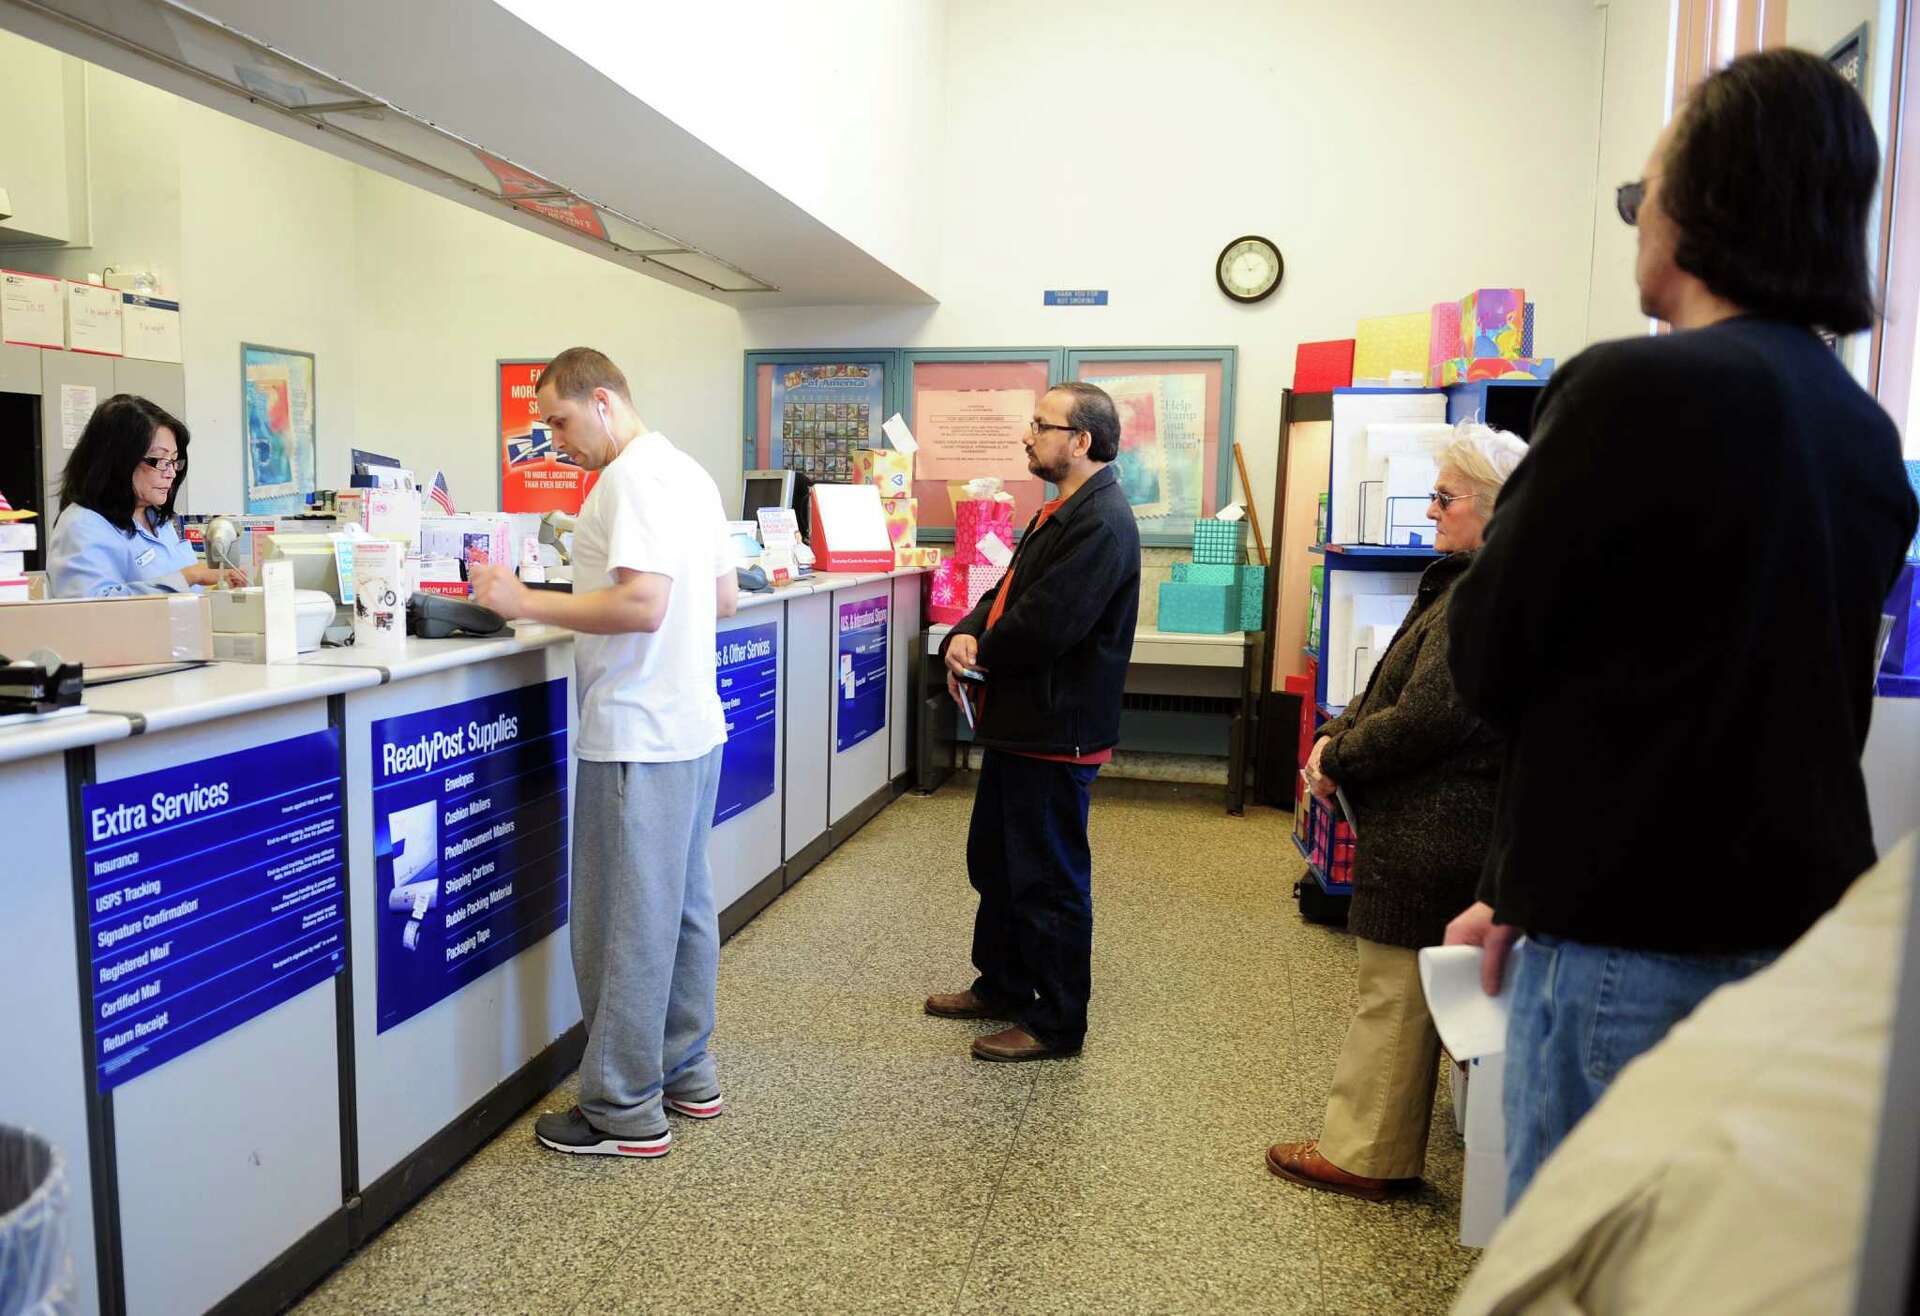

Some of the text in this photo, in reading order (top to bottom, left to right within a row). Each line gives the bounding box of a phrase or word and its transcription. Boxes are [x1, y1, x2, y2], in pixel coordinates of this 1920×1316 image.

[748, 638, 770, 660] Services
[383, 714, 518, 776] ReadyPost Supplies
[444, 771, 475, 793] Envelopes
[91, 780, 230, 841] Extra Services
[445, 796, 491, 827] Cushion Mailers
[444, 820, 515, 861] Photo/Document Mailers
[94, 851, 139, 876] Insurance
[445, 861, 495, 896] Shipping Cartons
[124, 879, 161, 904] Tracking
[446, 882, 512, 928] Bubble Packing Material
[97, 898, 198, 948] Signature Confirmation
[446, 927, 490, 962] Packaging Tape
[99, 951, 149, 983] Registered
[102, 987, 140, 1018] Certified
[103, 1012, 169, 1053] Return Receipt
